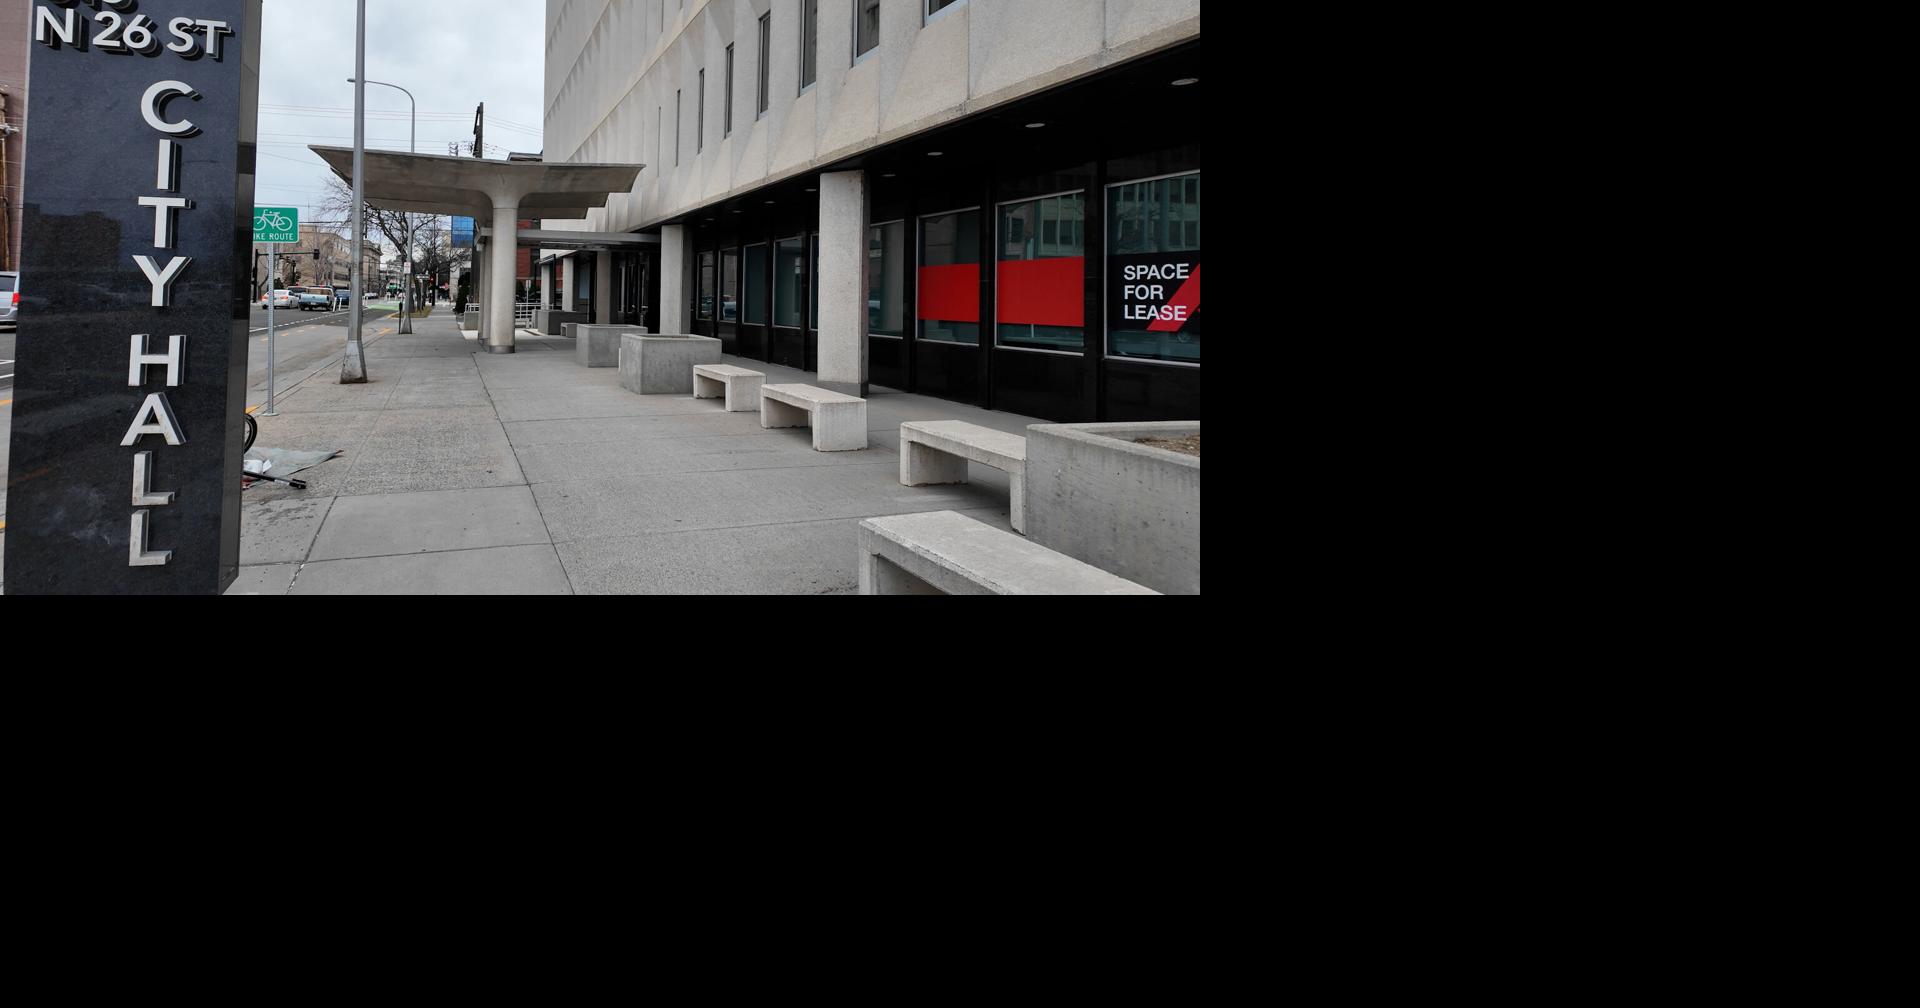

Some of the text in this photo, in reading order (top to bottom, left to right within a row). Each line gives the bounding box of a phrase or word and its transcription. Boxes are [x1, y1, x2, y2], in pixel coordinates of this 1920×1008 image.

[36, 5, 228, 54] N 26 ST
[253, 232, 294, 241] IKE ROUTE
[1123, 263, 1190, 280] SPACE
[1124, 284, 1164, 300] FOR
[1124, 304, 1187, 321] LEASE
[120, 80, 194, 567] CITY HALL
